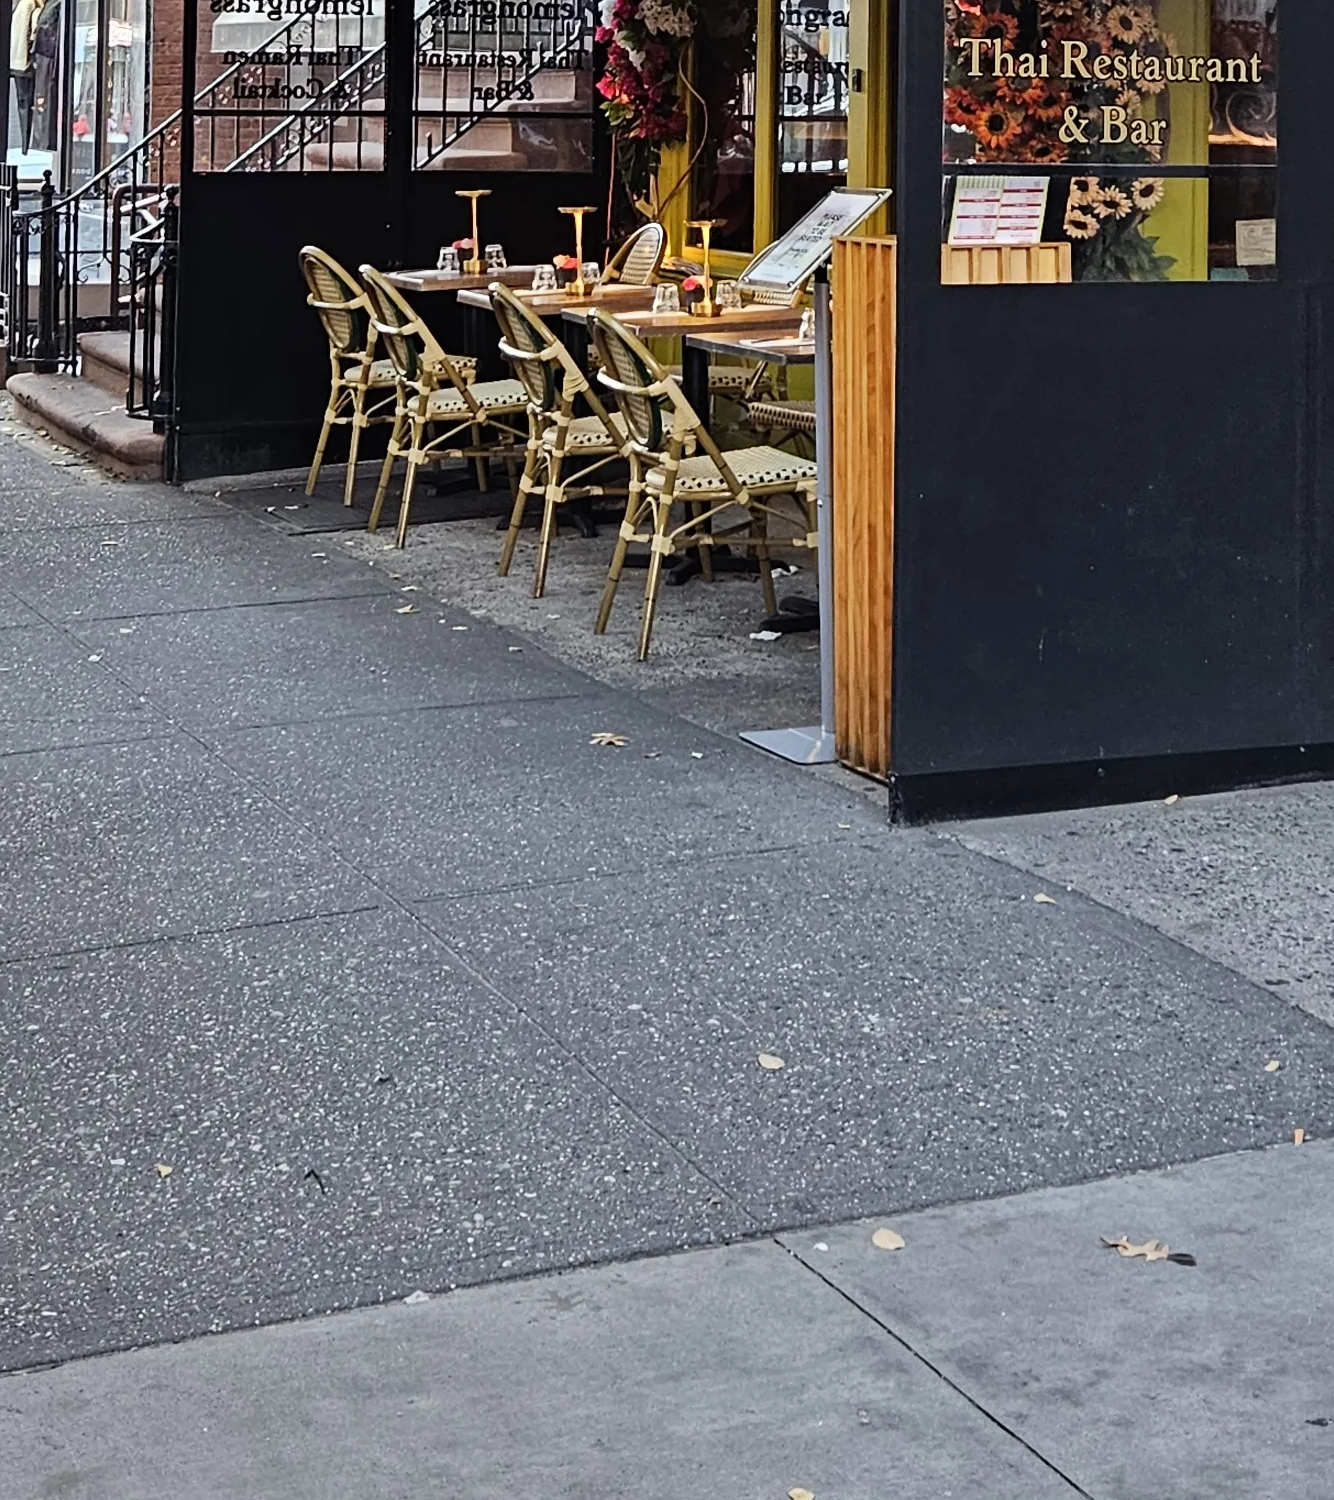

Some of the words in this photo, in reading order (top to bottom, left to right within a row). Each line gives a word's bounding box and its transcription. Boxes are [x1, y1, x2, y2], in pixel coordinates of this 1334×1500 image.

[960, 38, 1050, 78] Thai
[1060, 40, 1263, 83] Restaurant
[1058, 105, 1090, 144] &
[1099, 104, 1167, 145] Bar
